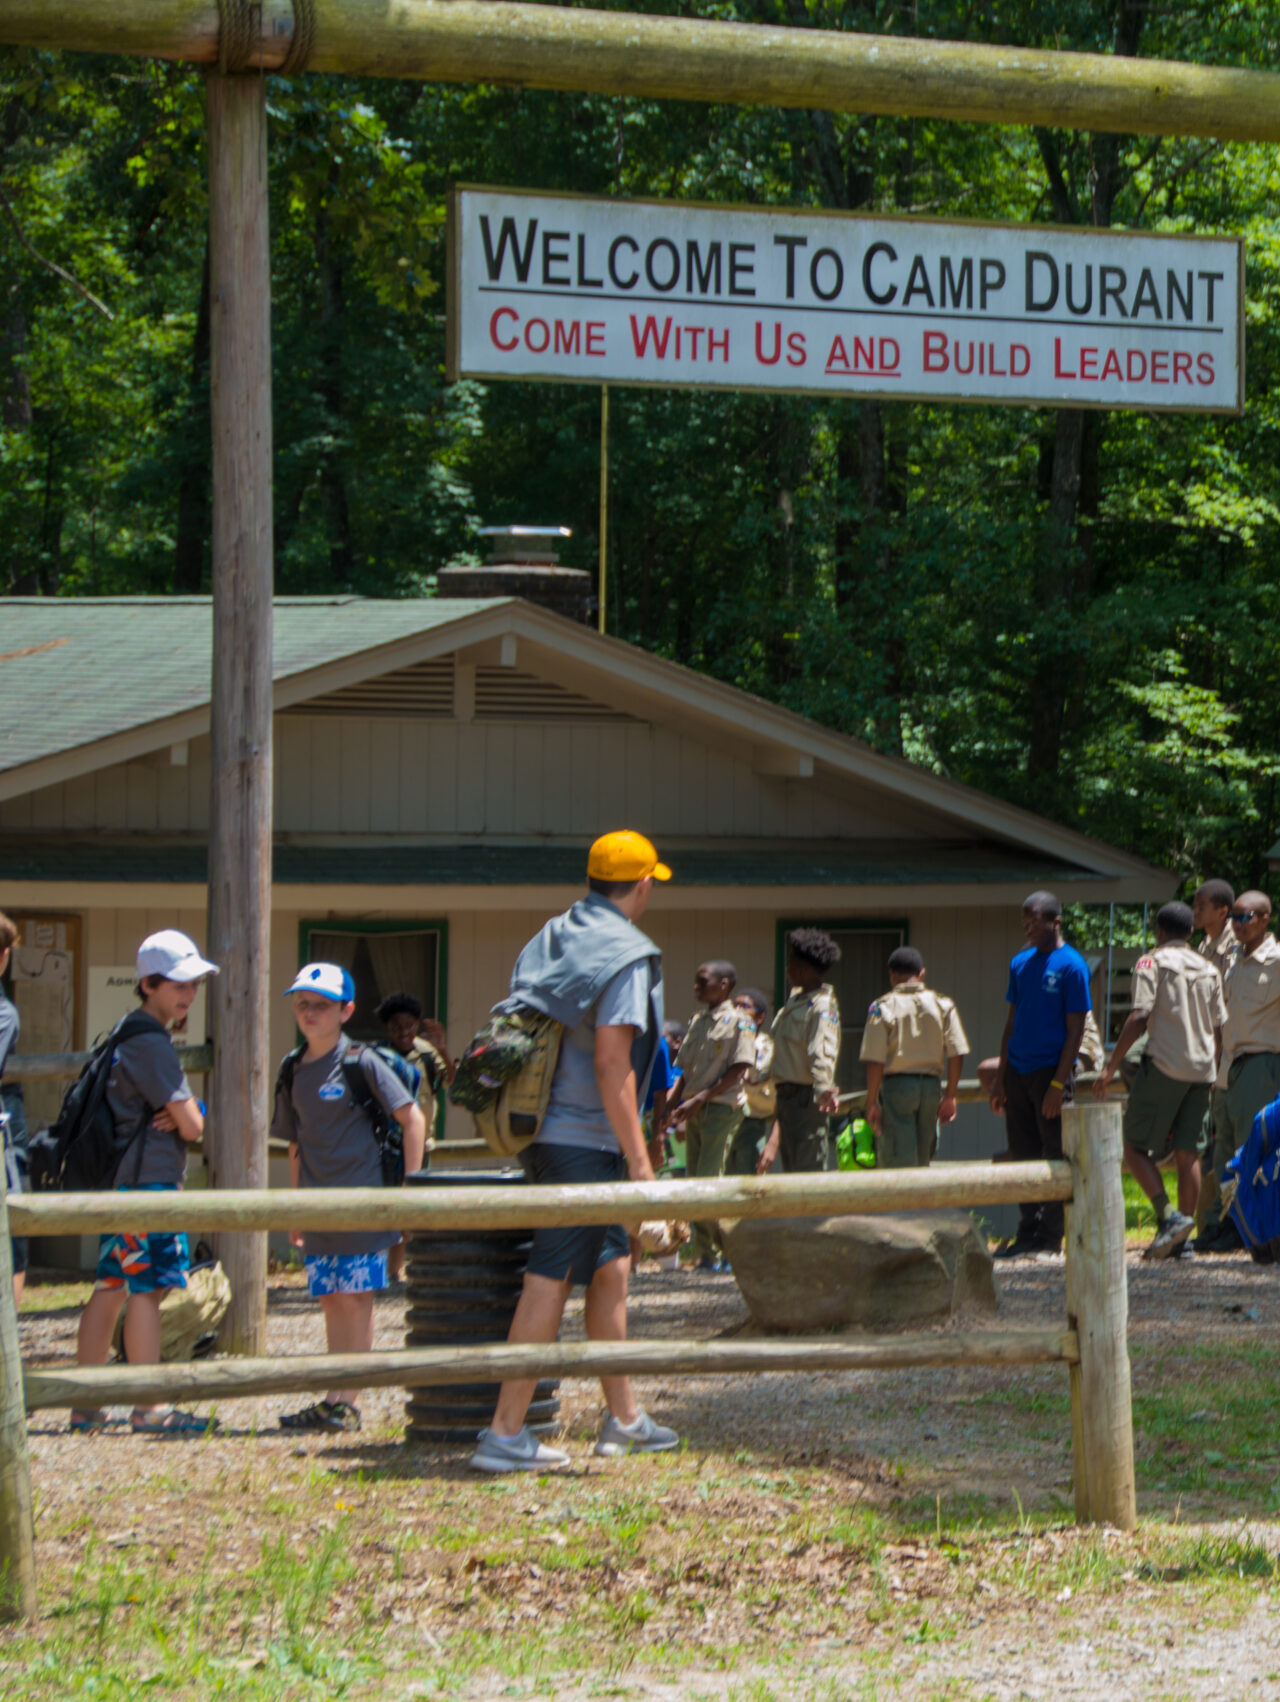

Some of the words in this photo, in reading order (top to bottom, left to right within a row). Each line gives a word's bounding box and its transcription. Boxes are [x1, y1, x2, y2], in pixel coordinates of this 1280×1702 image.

[478, 214, 756, 297] WELCOME
[773, 234, 844, 302] TO
[861, 240, 1007, 311] CAMP
[1024, 249, 1224, 323] DURANT
[489, 306, 607, 357] COME
[629, 313, 730, 363] WITH
[754, 321, 807, 367] US
[825, 334, 901, 372] AND
[922, 329, 1031, 378] BUILD
[1053, 336, 1216, 387] LEADERS
